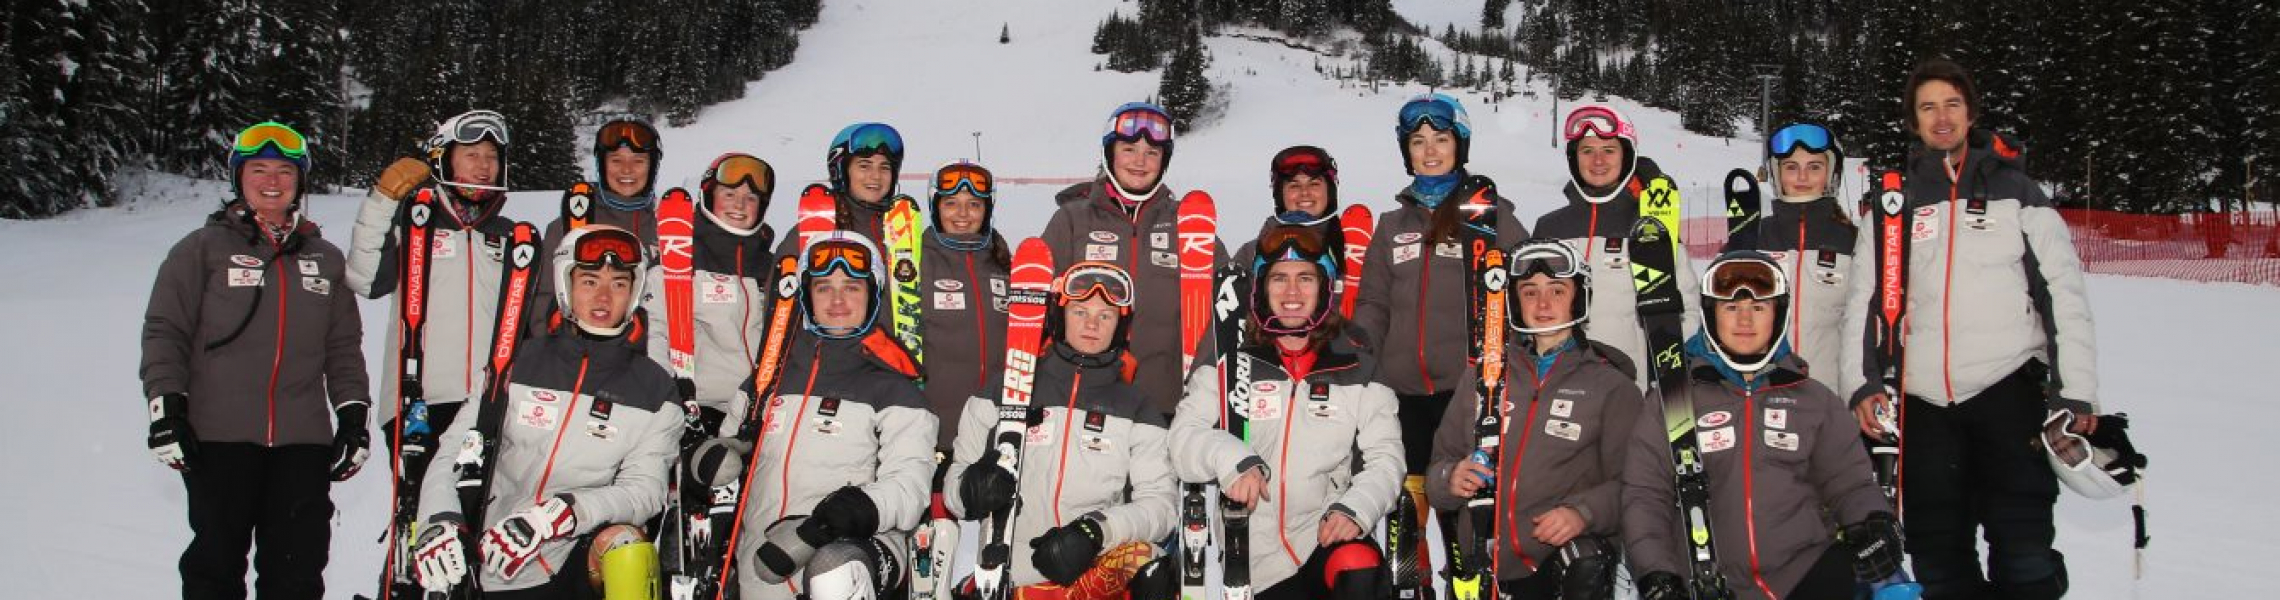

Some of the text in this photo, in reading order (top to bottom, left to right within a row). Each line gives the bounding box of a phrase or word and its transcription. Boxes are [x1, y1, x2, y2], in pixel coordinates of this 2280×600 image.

[409, 235, 422, 316] DYNASTAR
[1885, 224, 1899, 310] DYNASTAR
[498, 277, 525, 358] DYNASTAR
[760, 306, 788, 382] DYNASTAR
[1002, 348, 1036, 406] ERO
